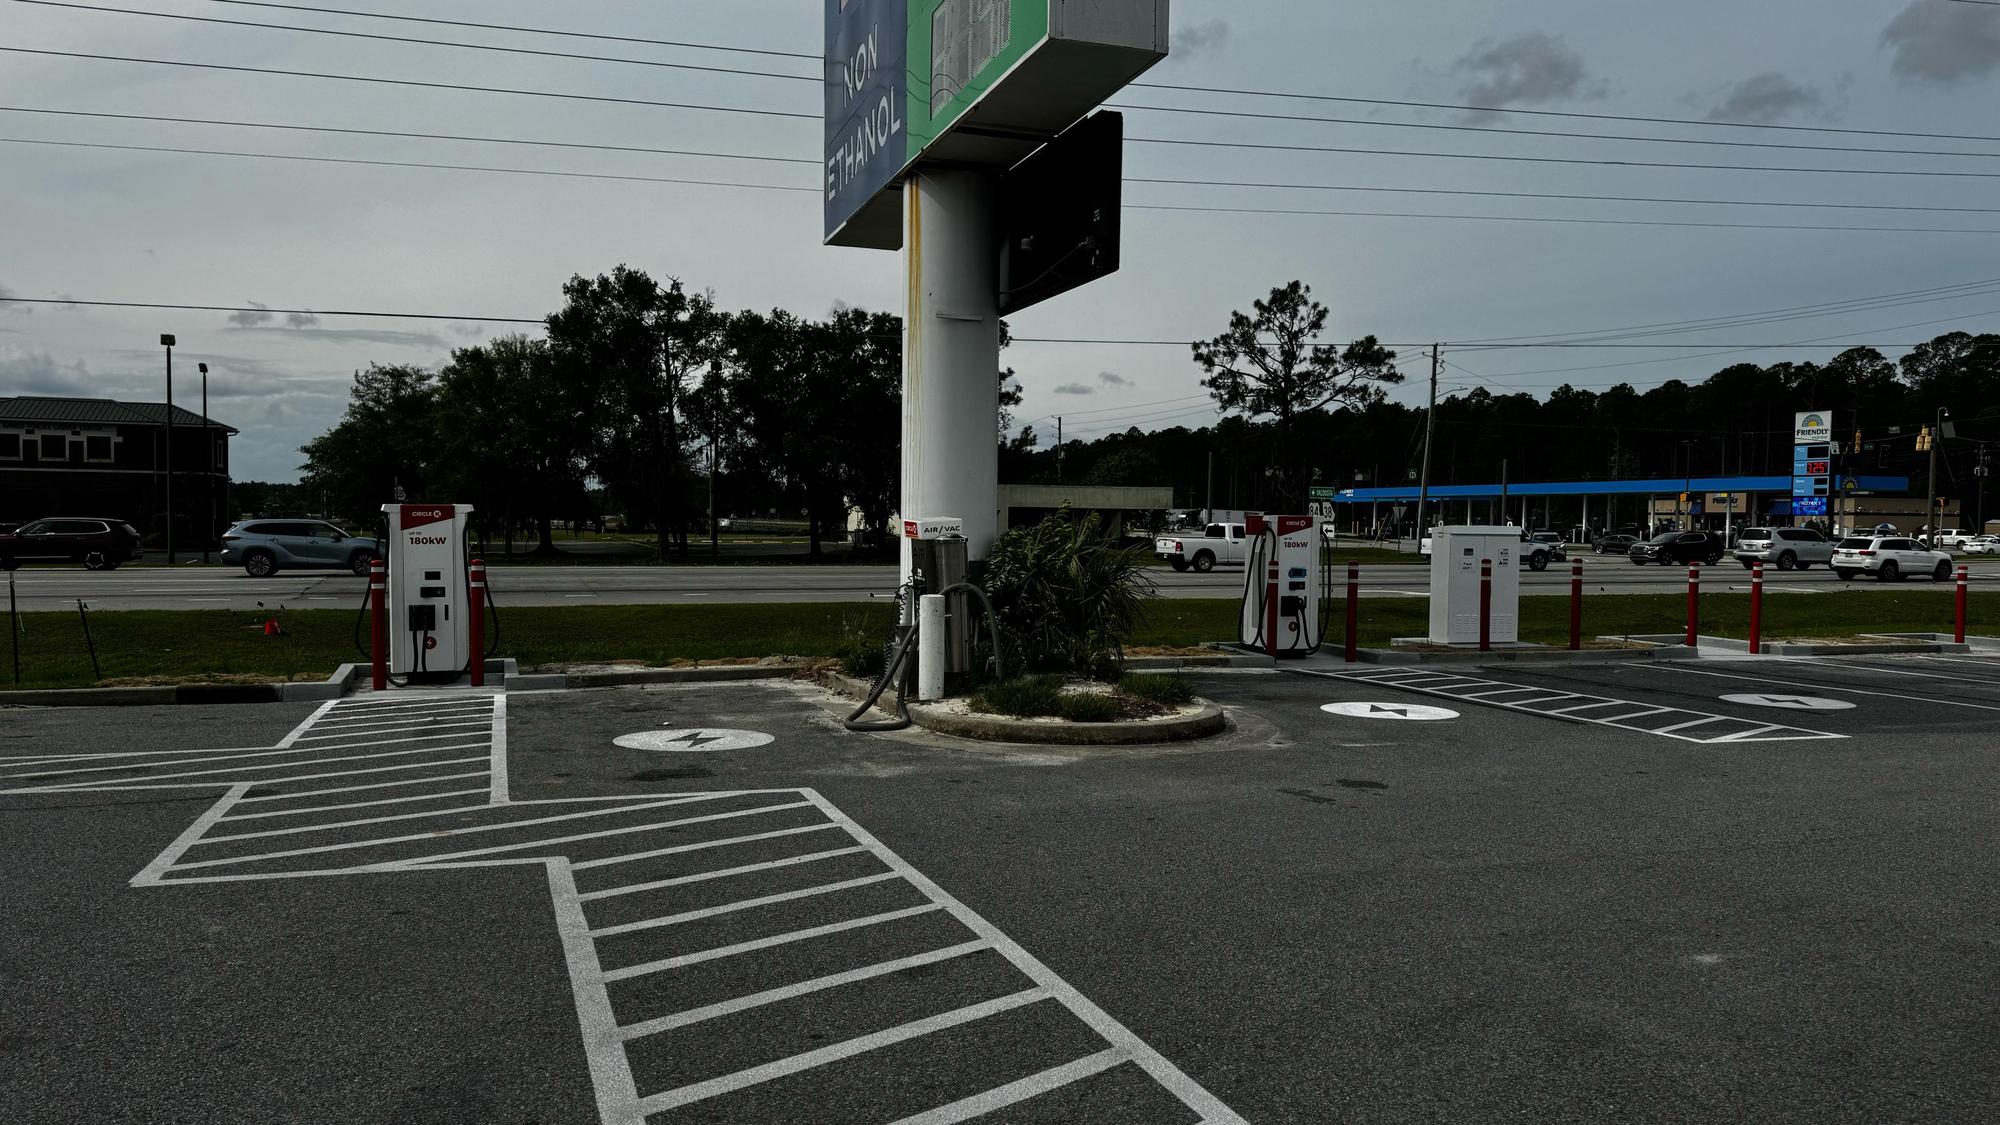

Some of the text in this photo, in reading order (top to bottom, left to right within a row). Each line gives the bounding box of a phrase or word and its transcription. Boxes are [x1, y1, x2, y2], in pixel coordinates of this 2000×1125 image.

[843, 23, 879, 109] NON
[828, 85, 901, 202] ETHANOL
[1796, 428, 1829, 436] FRIENDLY
[1309, 505, 1332, 518] 84 38
[924, 525, 961, 534] AIR/VAC
[409, 537, 446, 545] 180kW
